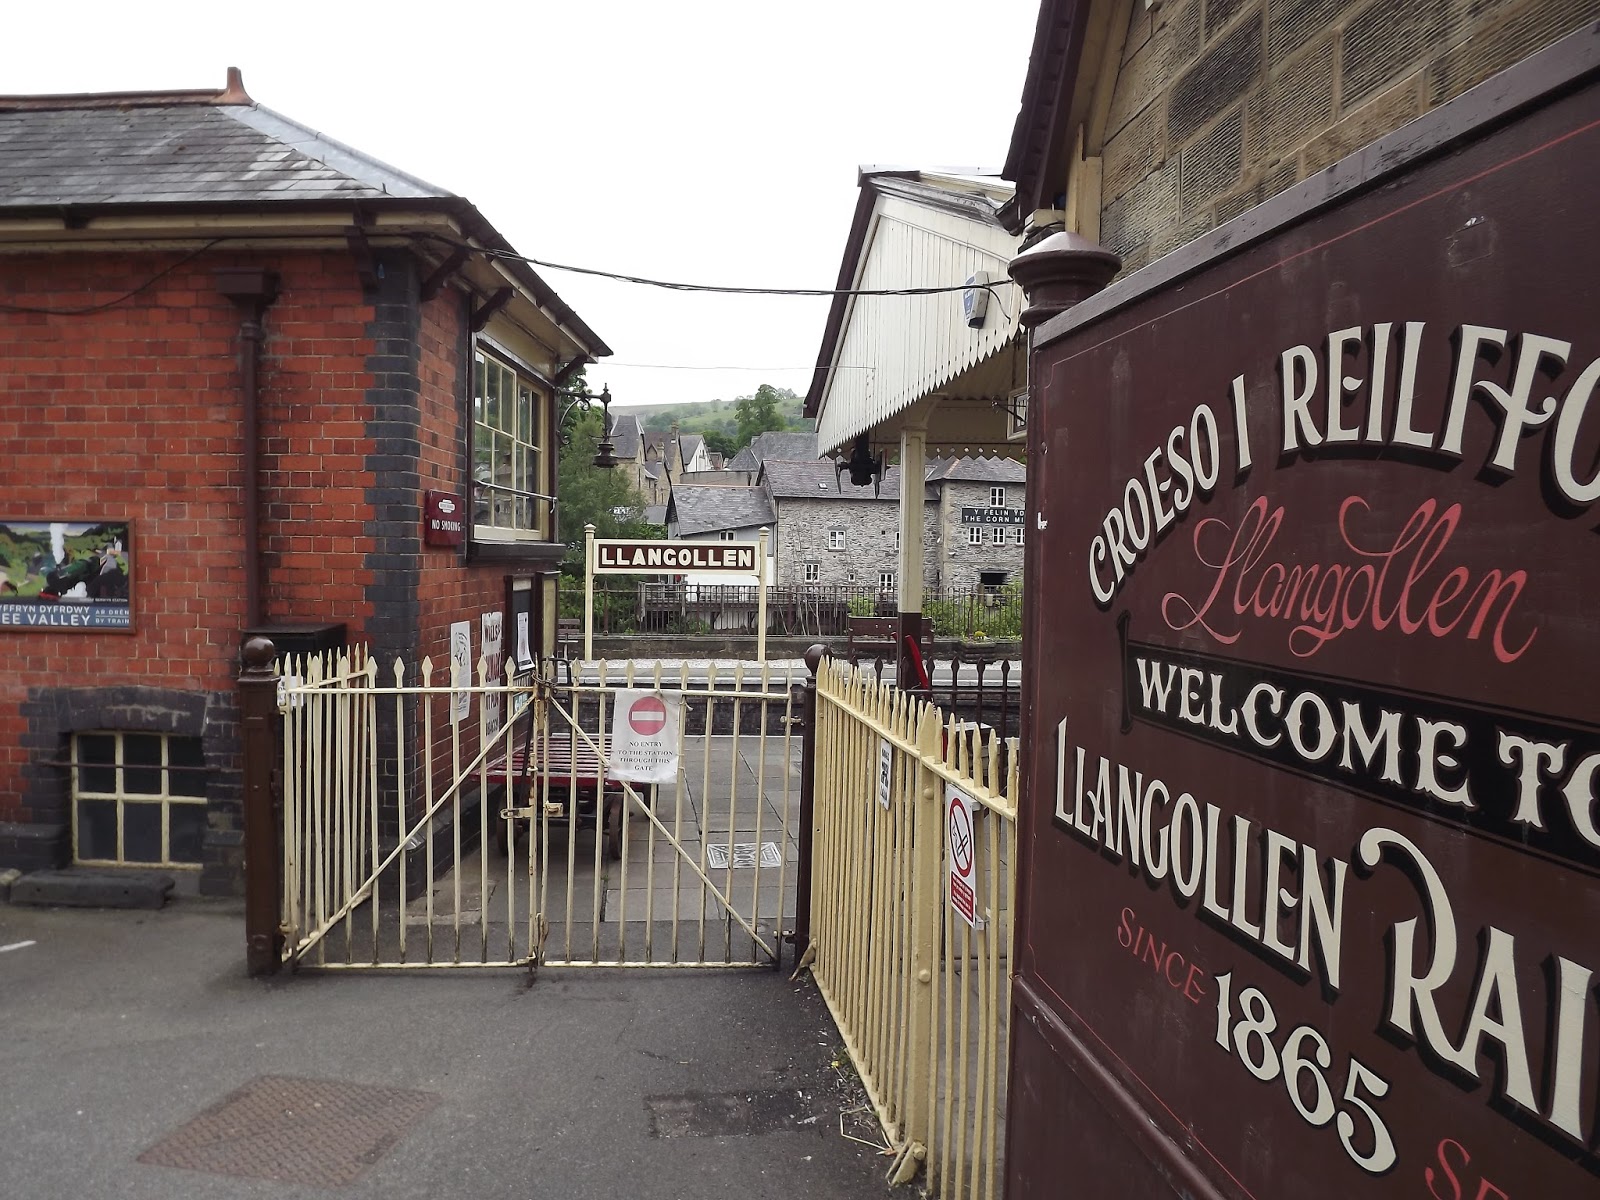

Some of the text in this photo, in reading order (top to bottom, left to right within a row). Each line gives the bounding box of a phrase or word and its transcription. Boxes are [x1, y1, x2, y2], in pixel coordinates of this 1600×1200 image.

[432, 519, 461, 531] NO SMOKING
[1088, 403, 1220, 603] CROESO
[1231, 373, 1253, 471] I
[39, 604, 90, 613] DYFRDWY
[601, 547, 752, 567] LLANGOLLEN
[1161, 494, 1538, 664] Llangollen
[27, 613, 90, 626] VALLEY
[1137, 658, 1476, 808] WELCOME
[1055, 717, 1348, 989] LLANGOLLEN
[1117, 907, 1207, 1005] SINCE
[1214, 972, 1397, 1173] 1865
